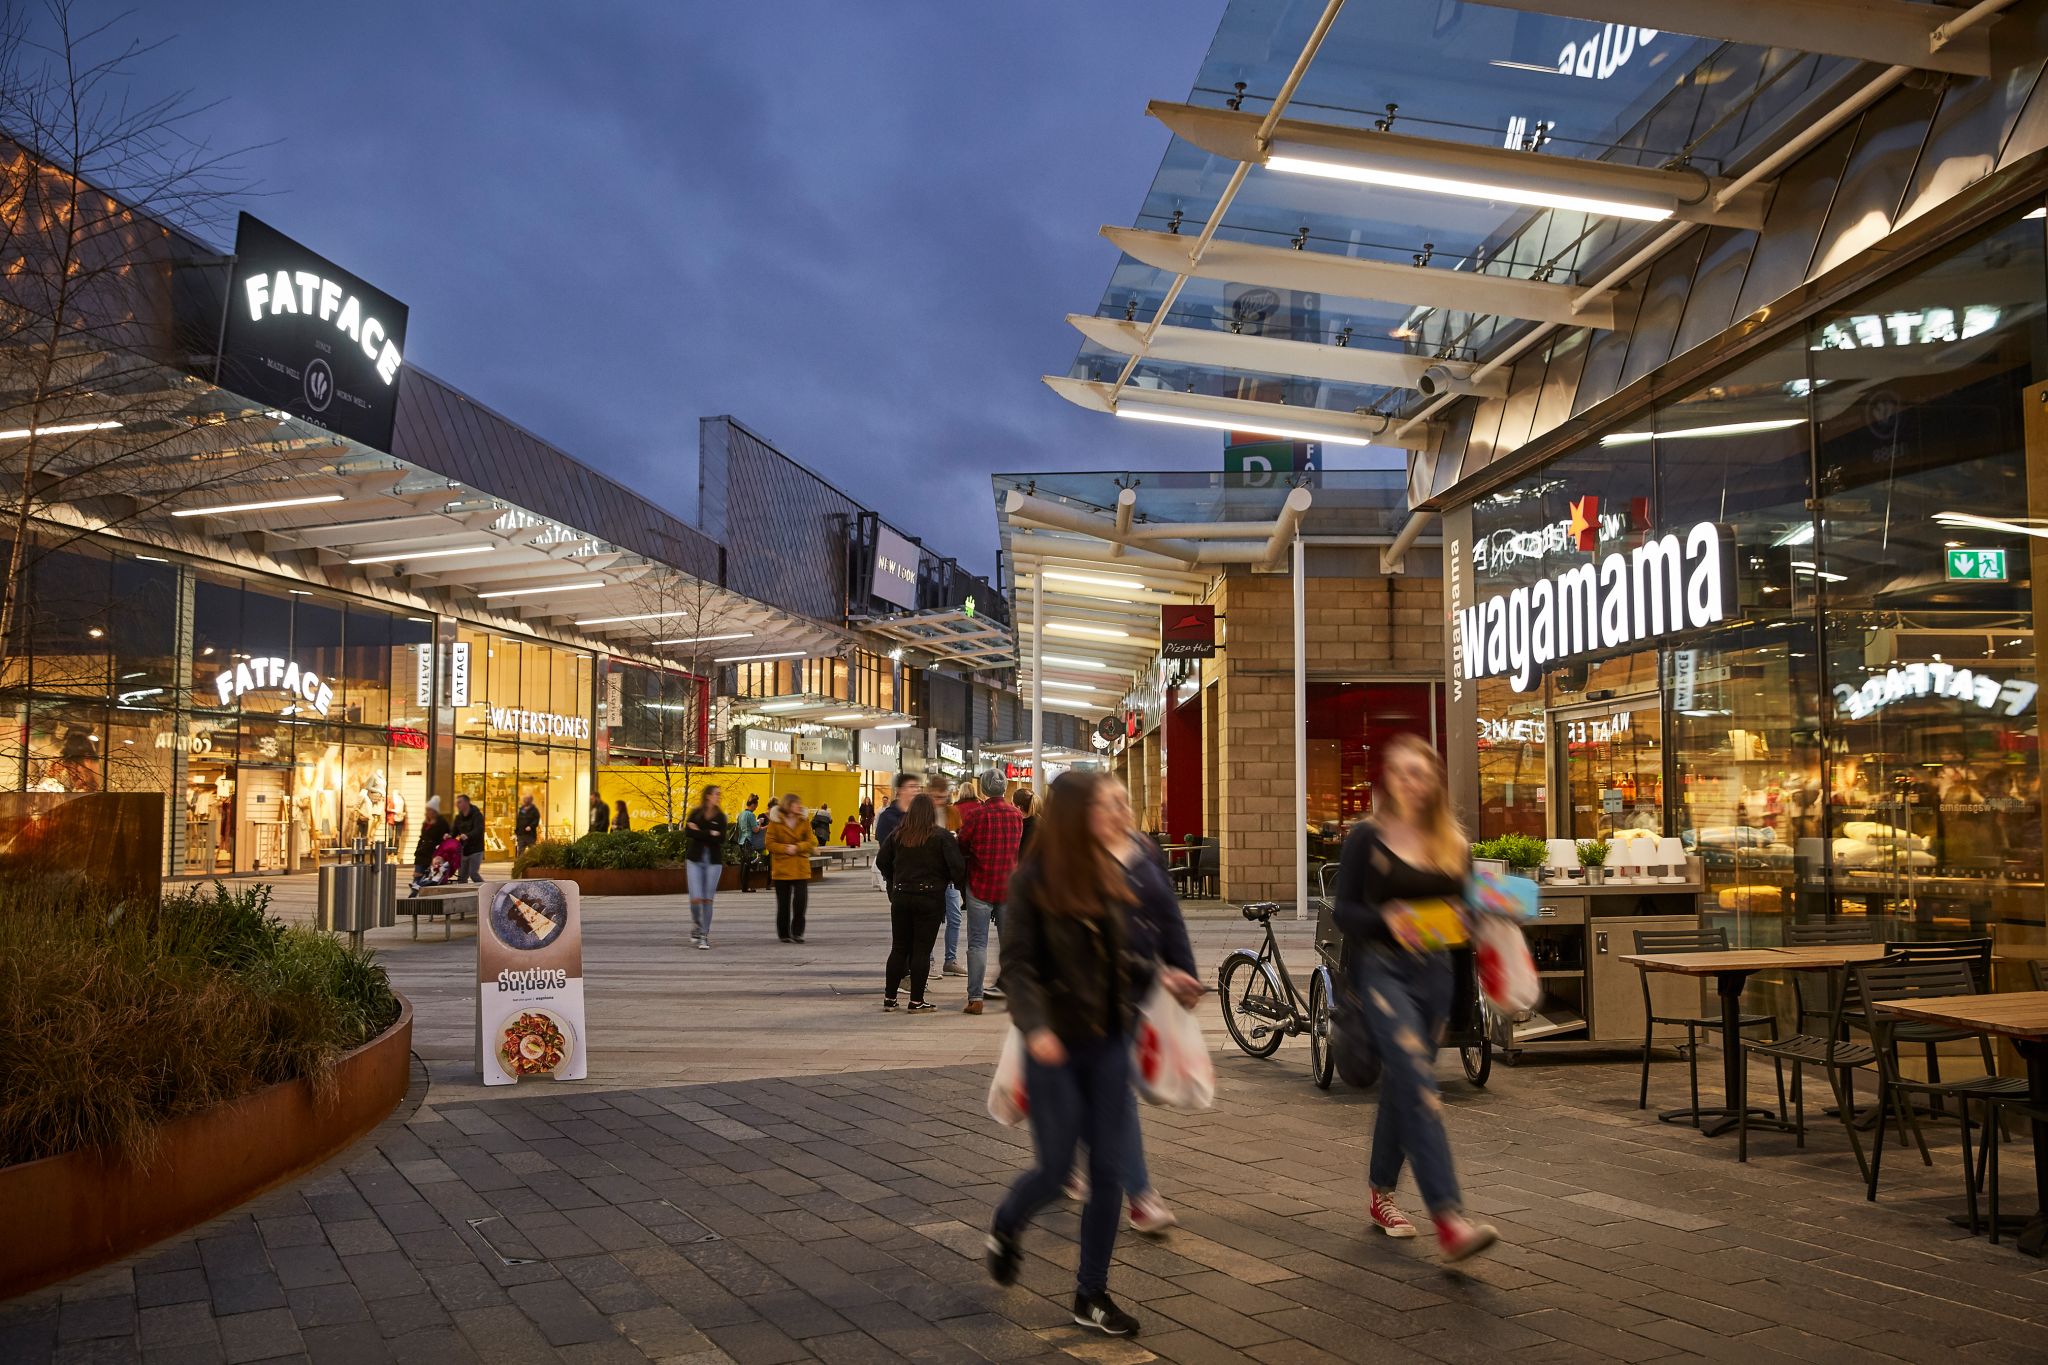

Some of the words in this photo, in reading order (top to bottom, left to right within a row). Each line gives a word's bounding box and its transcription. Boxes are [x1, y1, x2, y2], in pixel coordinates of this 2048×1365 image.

[245, 270, 402, 386] FATFACE
[267, 358, 285, 373] MADE
[285, 366, 301, 381] WELL
[1242, 455, 1273, 488] D
[878, 555, 896, 574] NEW
[897, 564, 916, 584] LOOK
[1450, 540, 1464, 703] wagamama
[1459, 521, 1724, 694] wagamama
[1164, 642, 1192, 653] Pizza
[1192, 643, 1213, 653] Hut
[215, 657, 334, 716] FATFACE
[489, 707, 589, 740] WATERSTONES
[750, 738, 767, 751] NEW
[769, 739, 789, 754] LOOK
[862, 741, 877, 754] NEW
[878, 741, 895, 756] LOOK
[498, 967, 566, 982] daytime
